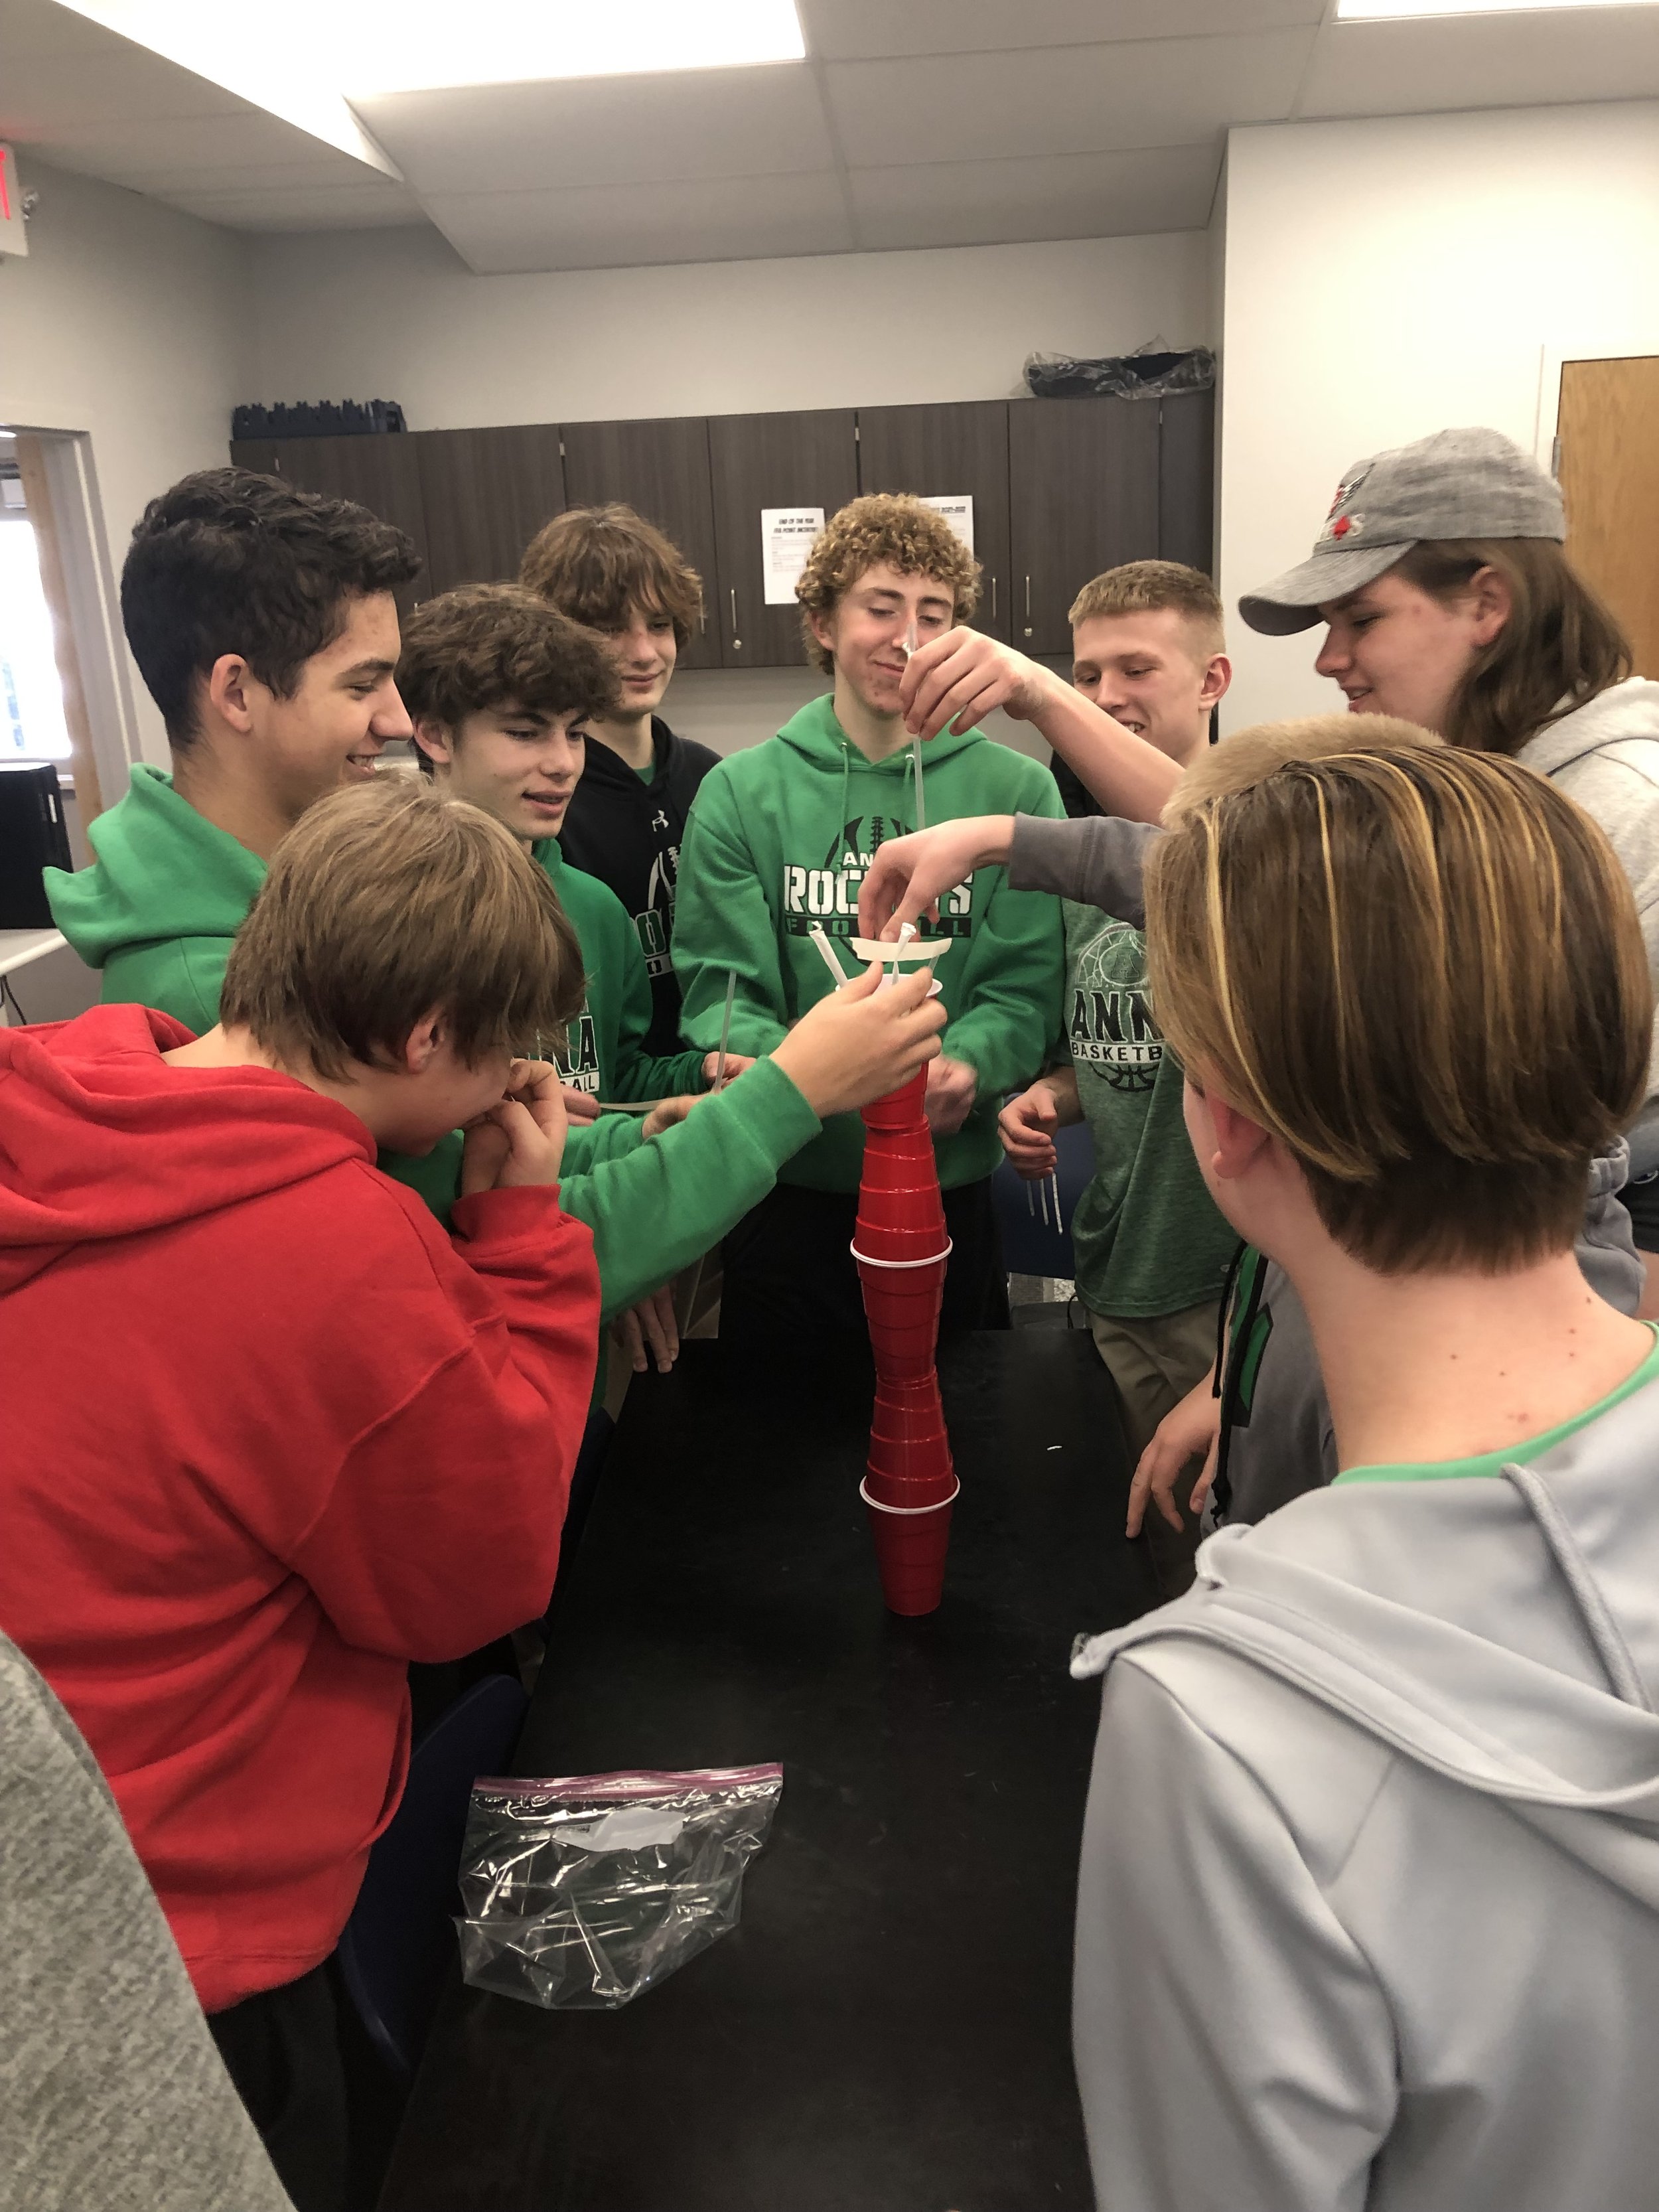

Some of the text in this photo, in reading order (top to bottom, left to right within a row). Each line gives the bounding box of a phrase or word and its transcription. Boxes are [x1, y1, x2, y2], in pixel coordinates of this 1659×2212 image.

[843, 851, 873, 866] AN
[784, 865, 972, 915] ROCS
[1070, 988, 1165, 1043] ANN
[1072, 1044, 1162, 1061] BASKETB
